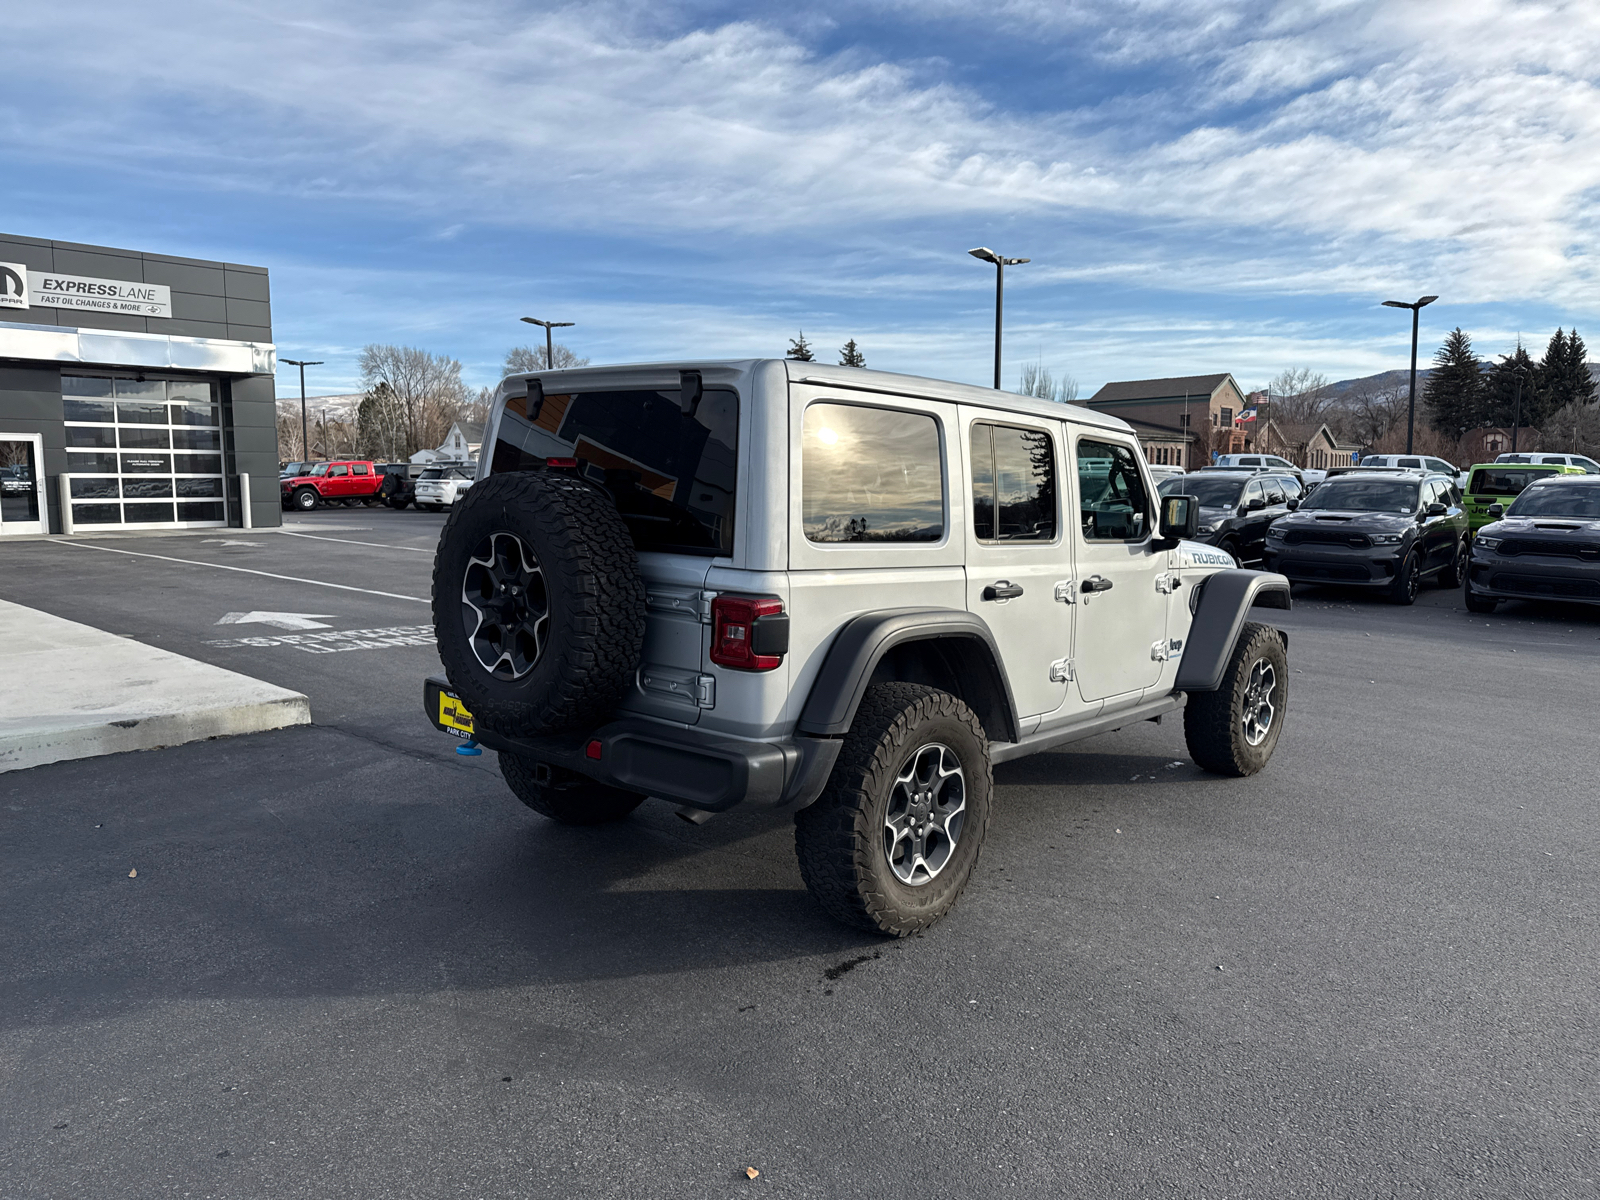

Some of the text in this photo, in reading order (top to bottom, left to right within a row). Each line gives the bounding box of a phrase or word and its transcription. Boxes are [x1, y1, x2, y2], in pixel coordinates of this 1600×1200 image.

[0, 297, 23, 305] PAR
[41, 295, 62, 304] FAST
[61, 297, 74, 306] OIL
[75, 299, 111, 310] CHANGES
[112, 302, 119, 310] &
[119, 303, 141, 312] MORE
[1192, 552, 1235, 567] RUBICON
[446, 726, 471, 740] PARK CITY
